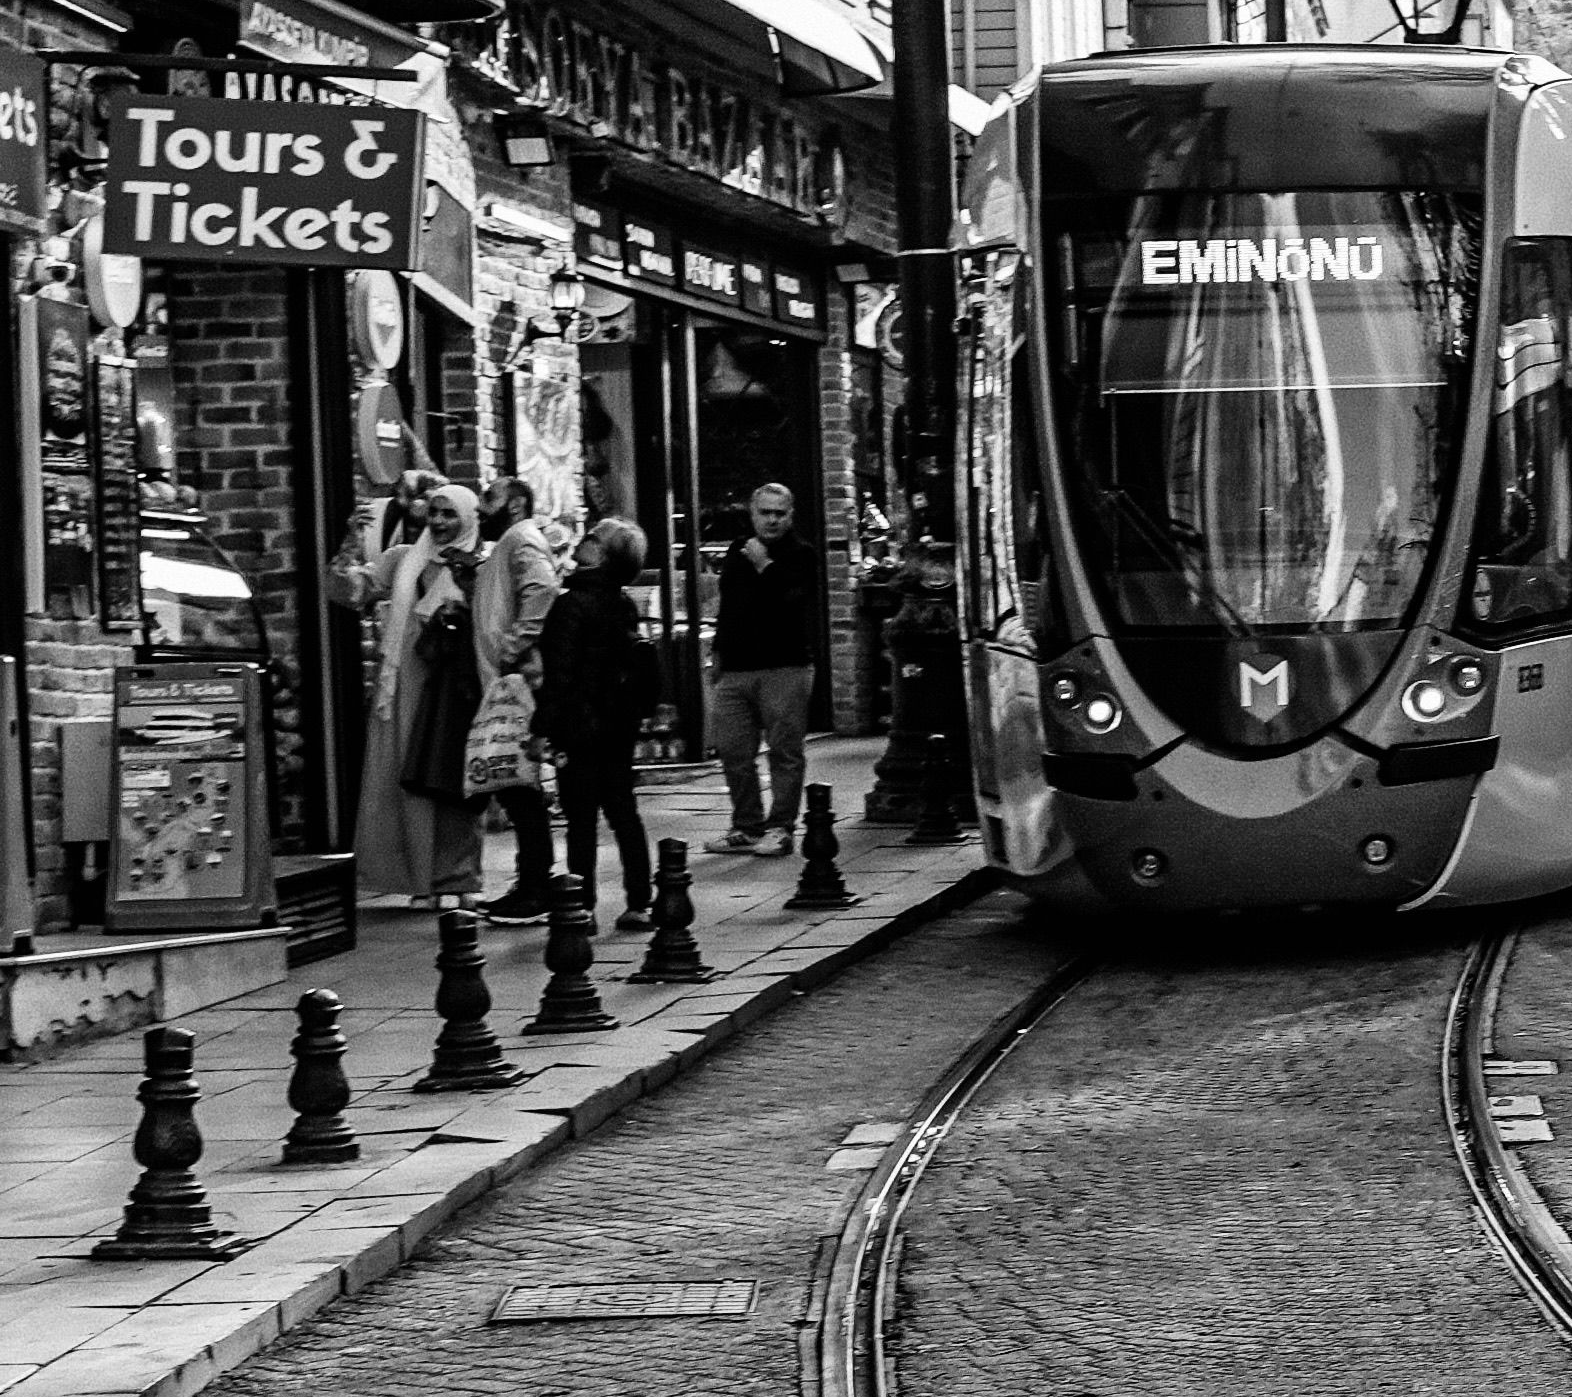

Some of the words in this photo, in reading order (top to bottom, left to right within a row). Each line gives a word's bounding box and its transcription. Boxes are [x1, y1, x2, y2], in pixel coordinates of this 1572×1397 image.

[126, 107, 325, 177] Tours
[344, 119, 398, 180] &
[122, 180, 394, 254] Tickets
